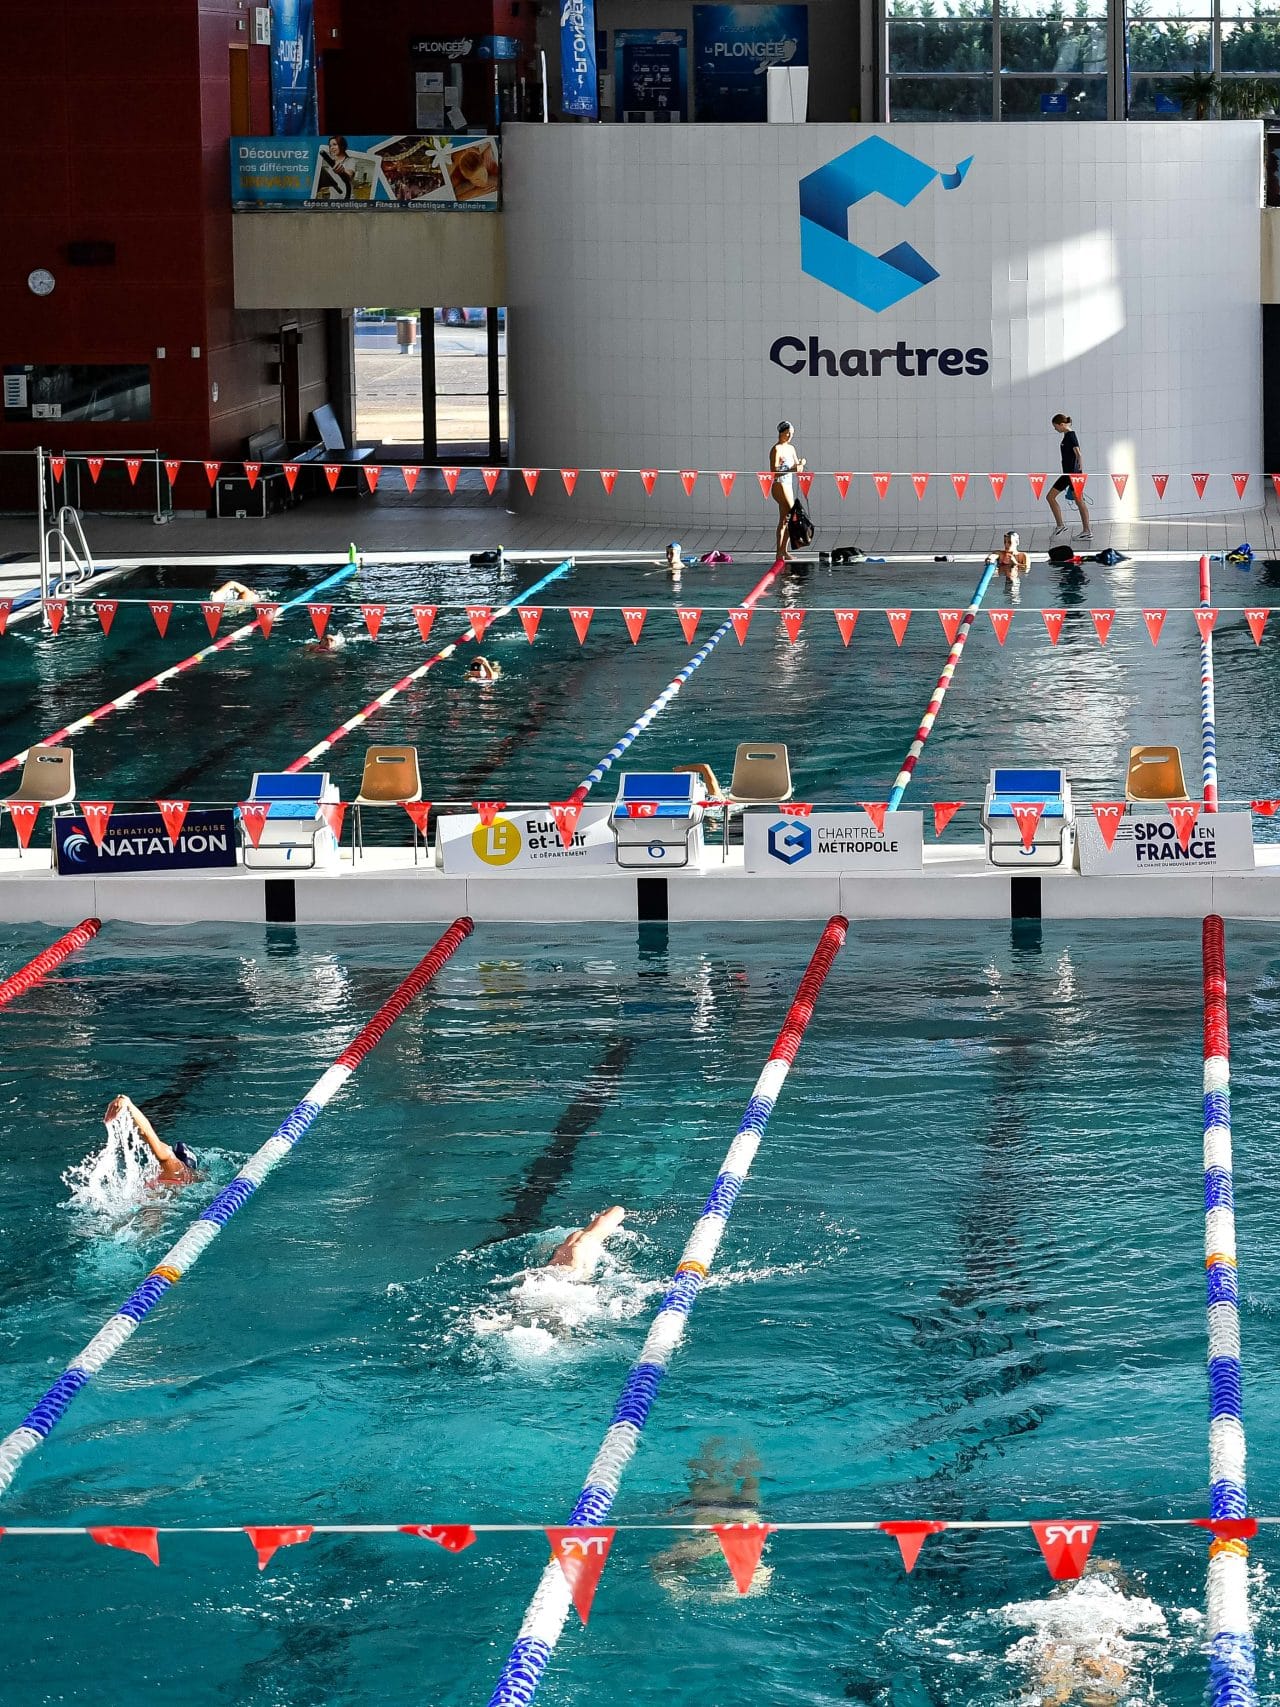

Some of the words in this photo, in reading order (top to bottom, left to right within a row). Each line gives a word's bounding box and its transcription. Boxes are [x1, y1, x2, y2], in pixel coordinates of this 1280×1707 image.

[240, 147, 310, 159] Découvrez
[259, 163, 309, 172] différents
[330, 201, 367, 209] aquatique
[408, 201, 445, 209] Esthétique
[769, 335, 990, 377] Chartres
[12, 806, 34, 815] TYR
[85, 806, 106, 815] TYR
[161, 803, 183, 812] TYR
[242, 806, 264, 815] TYR
[554, 807, 576, 816] TYR
[1014, 807, 1037, 816] TYR
[1095, 807, 1118, 816] TYR
[1171, 807, 1193, 816] TYR
[817, 827, 885, 839] CHARTRES
[1135, 821, 1198, 840] SPOT
[1199, 828, 1214, 839] EN
[98, 834, 227, 857] NATATION
[648, 839, 665, 858] 6
[818, 839, 899, 853] MÉTROPOLE
[539, 850, 587, 859] DÉPARTEMENT
[1136, 841, 1216, 860] FRANCE
